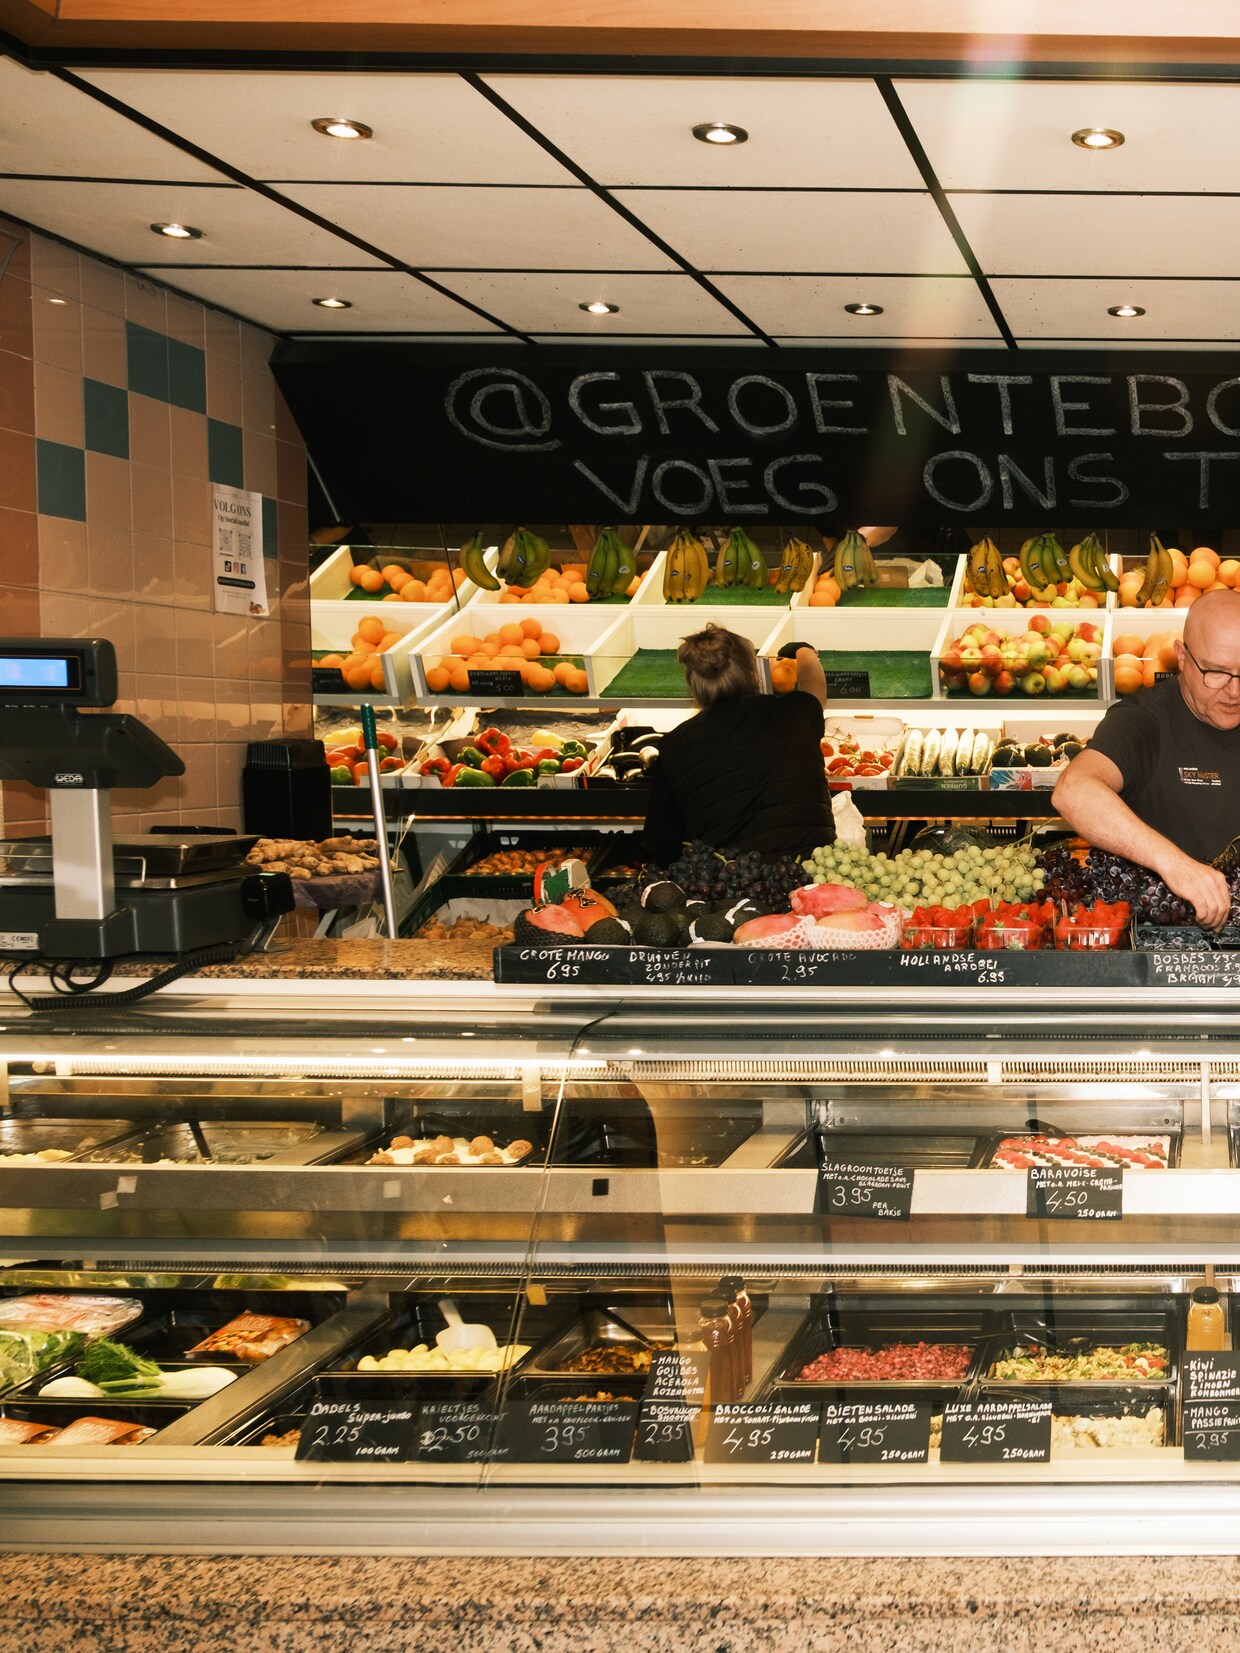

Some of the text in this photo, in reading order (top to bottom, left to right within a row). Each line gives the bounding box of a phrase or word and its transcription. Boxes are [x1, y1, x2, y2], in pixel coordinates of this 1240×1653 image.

[573, 453, 838, 515] VOEG
[923, 450, 1131, 511] ONS
[213, 499, 252, 517] VOLG ONS
[520, 949, 610, 962] GROTE MANGO
[799, 952, 857, 962] AVOCADO
[900, 953, 975, 967] HOLLANDSE
[1153, 953, 1205, 965] BOSBES
[944, 959, 998, 972] AARDBEI
[782, 965, 818, 981] 2.95
[978, 970, 1005, 984] 6.95
[1168, 972, 1217, 984] BRAAM
[1030, 1168, 1097, 1179] BARAVOISE
[832, 1186, 874, 1206] 3.95
[1046, 1190, 1088, 1212] 4.50
[878, 1207, 902, 1216] BAKJE
[1078, 1208, 1116, 1218] 250 GRAM
[657, 1356, 692, 1366] MANGO
[1190, 1358, 1214, 1372] KIWI
[1190, 1368, 1236, 1382] SPINAZIE
[654, 1377, 699, 1387] ACEROLA
[1190, 1380, 1231, 1390] LIMOEN
[310, 1403, 360, 1416] DADELS
[945, 1404, 972, 1414] LUXE
[1190, 1406, 1229, 1418] MANGO
[311, 1425, 364, 1446] 2.25
[644, 1423, 686, 1444] 2.95
[836, 1425, 888, 1452] 4.95
[962, 1424, 1006, 1448] 4.95
[722, 1428, 776, 1454] 4.95
[1195, 1432, 1230, 1449] 2.95
[356, 1446, 400, 1456] 100 GRAM
[574, 1449, 621, 1459] 500 GRAM
[770, 1450, 790, 1460] 250
[881, 1450, 901, 1460] 250
[1002, 1448, 1023, 1459] 250
